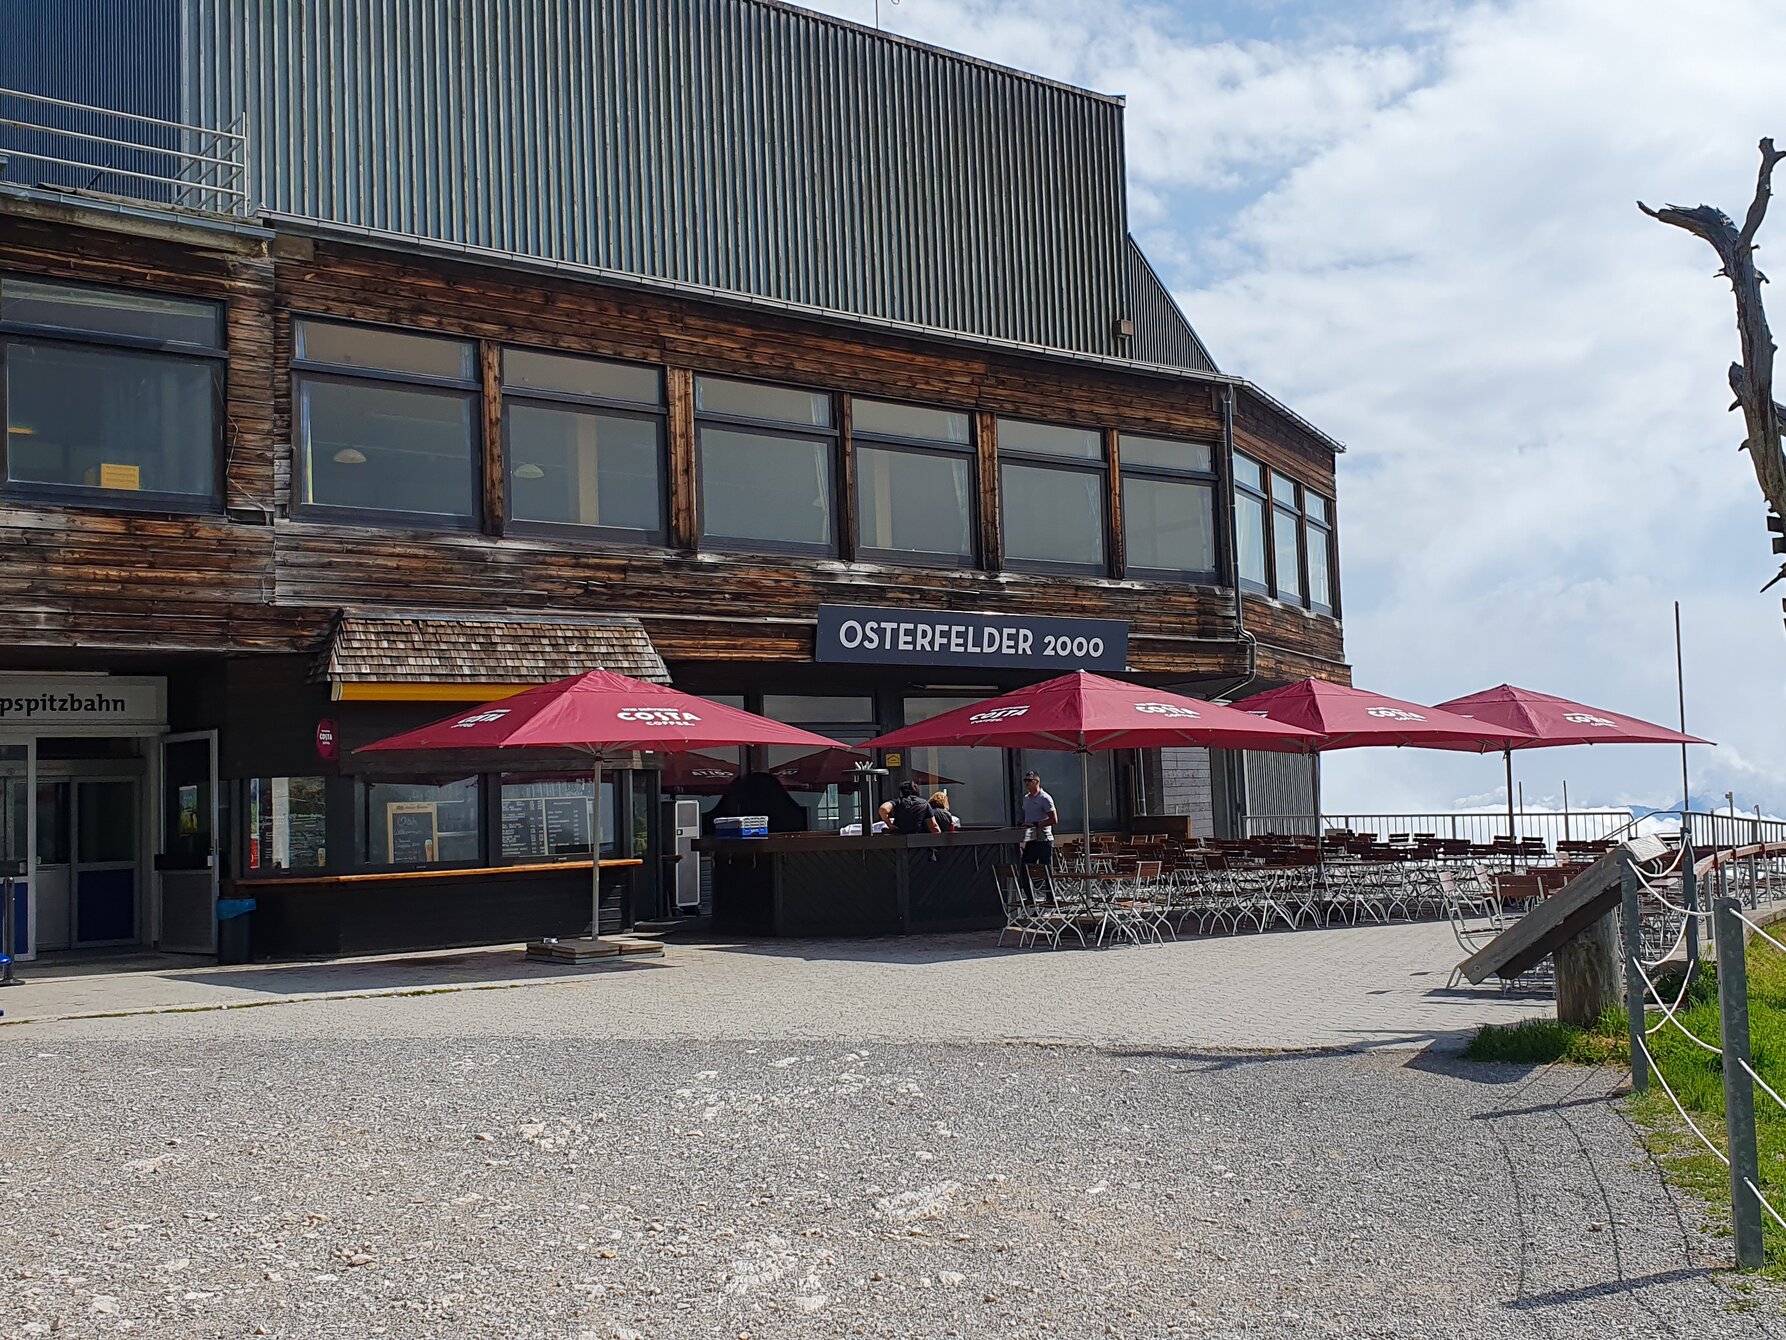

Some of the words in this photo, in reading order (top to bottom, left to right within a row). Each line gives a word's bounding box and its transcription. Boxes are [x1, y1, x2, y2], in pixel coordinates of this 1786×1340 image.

[839, 620, 1034, 655] OSTERFELDER
[1042, 635, 1105, 658] 2000
[0, 693, 125, 716] pspitzbahn
[617, 711, 702, 721] COSTA
[969, 709, 1029, 721] COSTA
[1135, 706, 1201, 715] COSTA
[319, 733, 333, 741] COSTA
